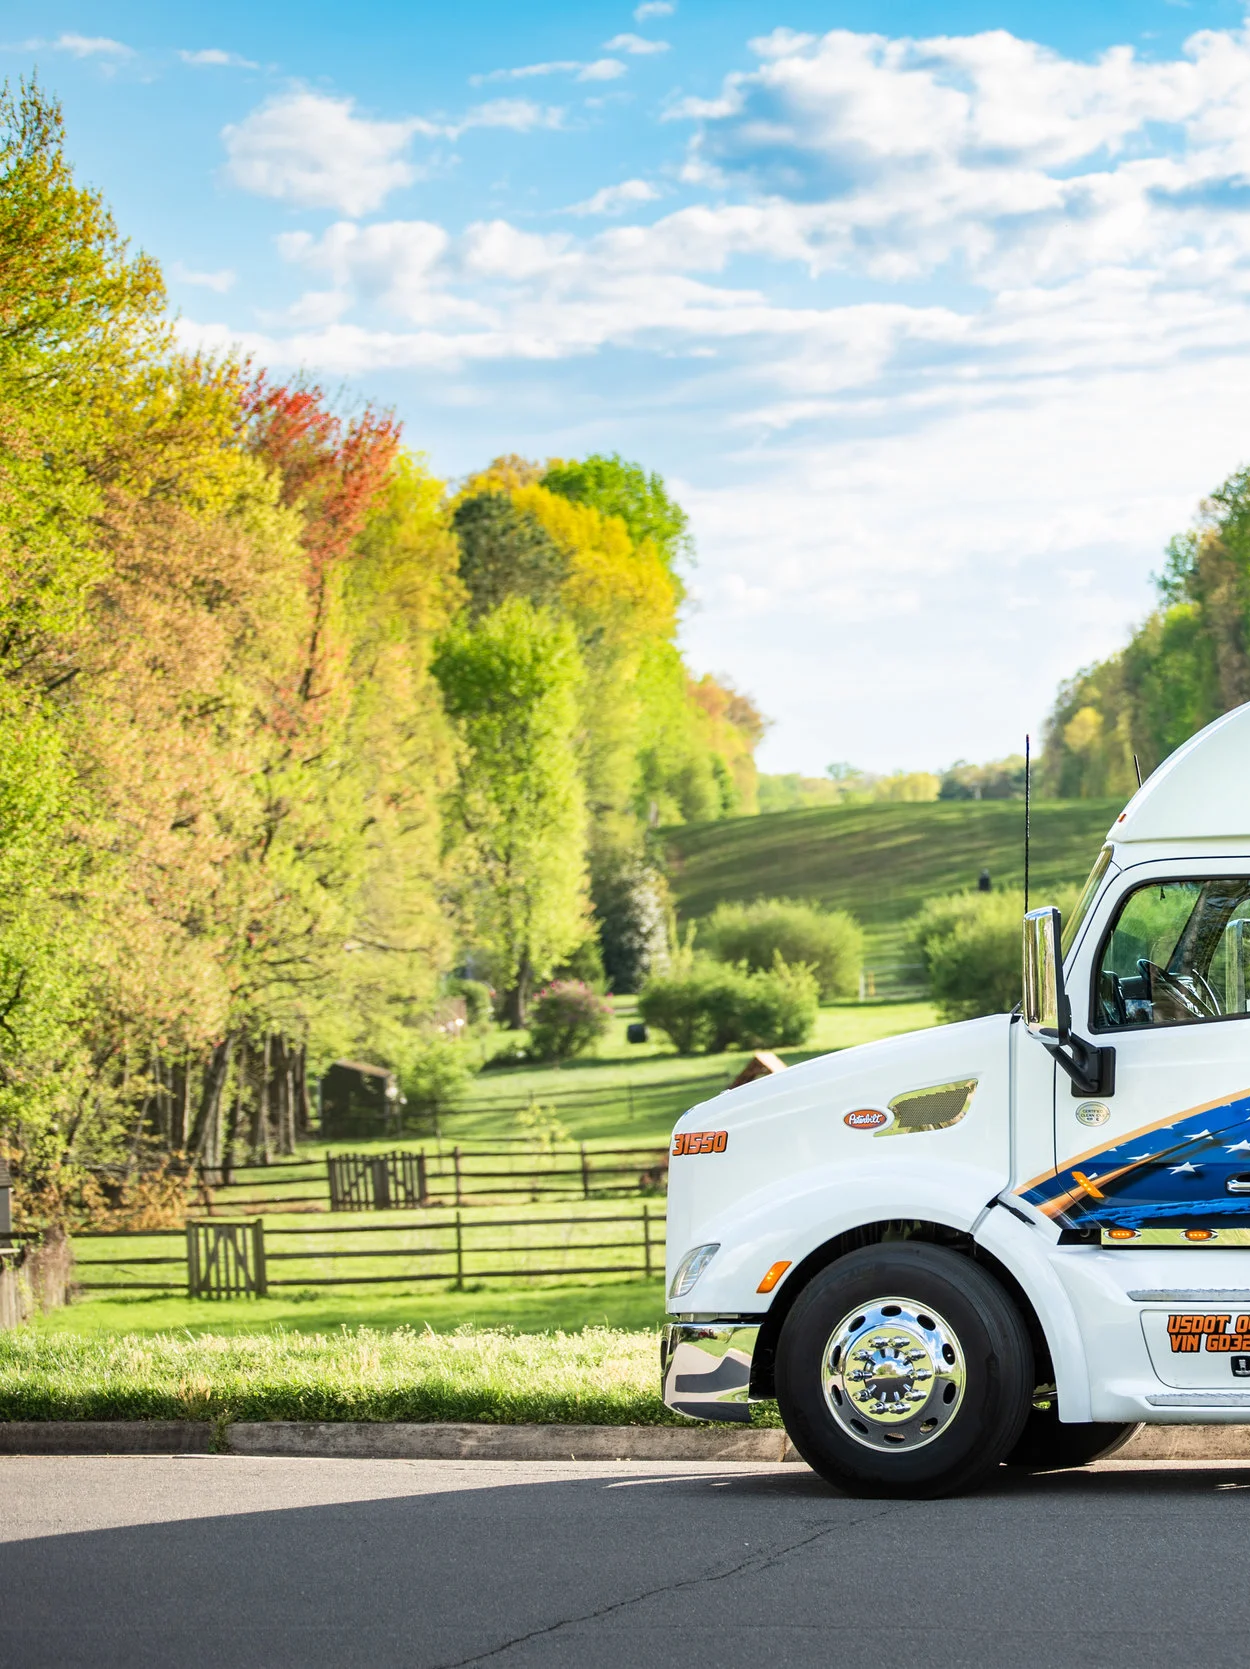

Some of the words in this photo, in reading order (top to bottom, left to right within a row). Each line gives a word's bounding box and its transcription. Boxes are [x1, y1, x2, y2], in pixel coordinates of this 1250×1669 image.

[849, 1113, 883, 1125] Peterbilt
[672, 1131, 728, 1156] 31550
[1167, 1315, 1231, 1334] USDOT
[1170, 1333, 1201, 1352] VIN
